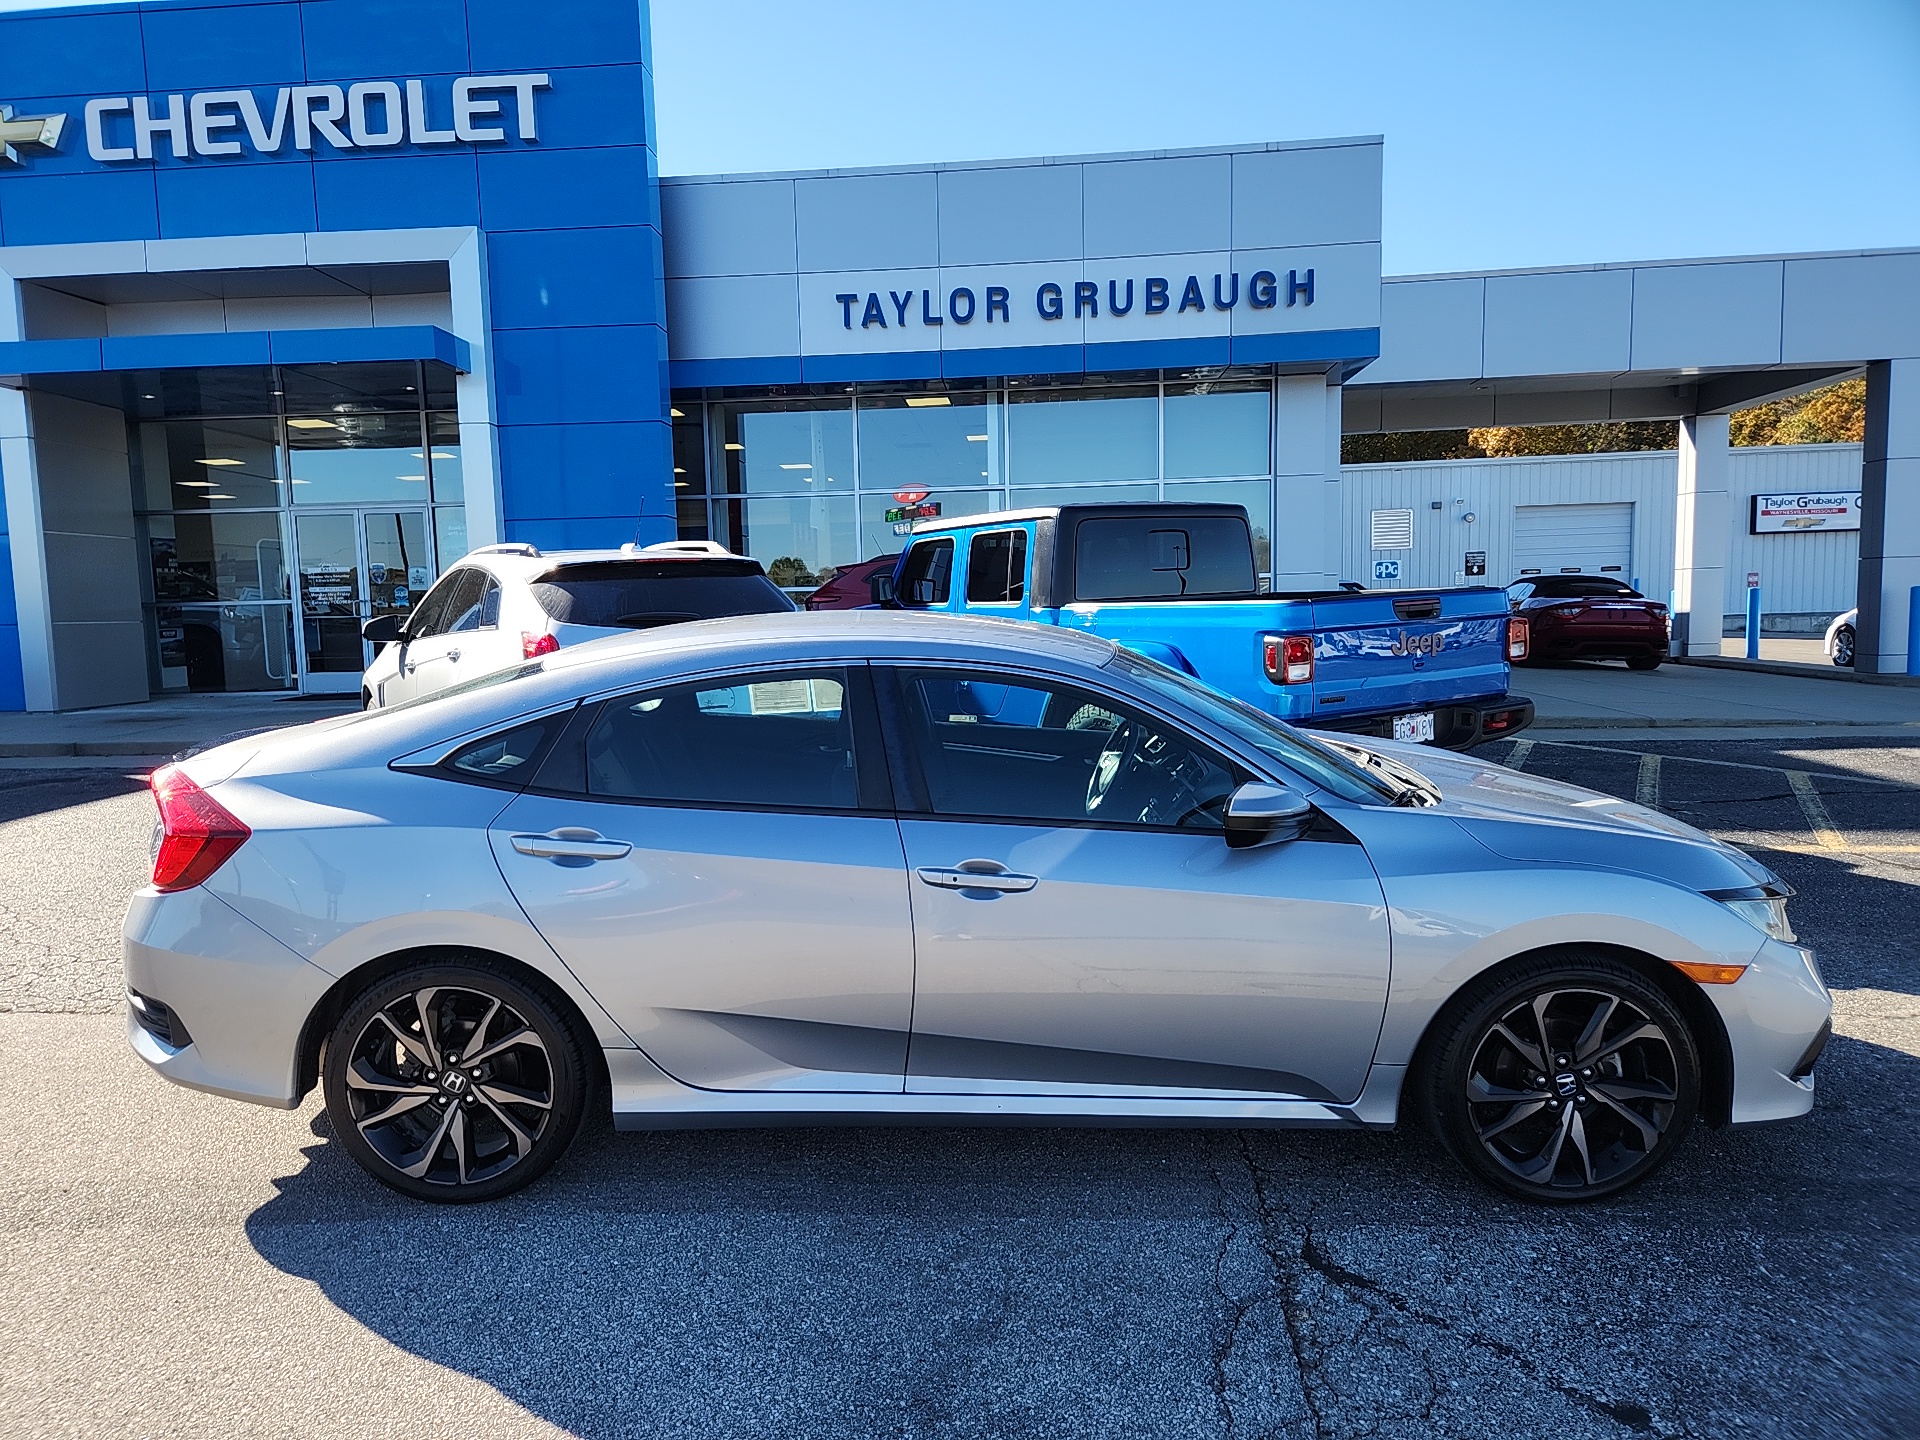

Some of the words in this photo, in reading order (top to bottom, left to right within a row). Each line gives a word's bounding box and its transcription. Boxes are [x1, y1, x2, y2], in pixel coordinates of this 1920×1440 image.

[84, 72, 553, 161] CHEVROLET
[835, 285, 1010, 330] TAYLOR
[1036, 268, 1316, 320] GRUBAUGH
[1761, 497, 1795, 509] Taylor
[1797, 496, 1848, 508] Grubaugh
[1376, 562, 1398, 578] PPG
[1391, 629, 1444, 657] Jeep
